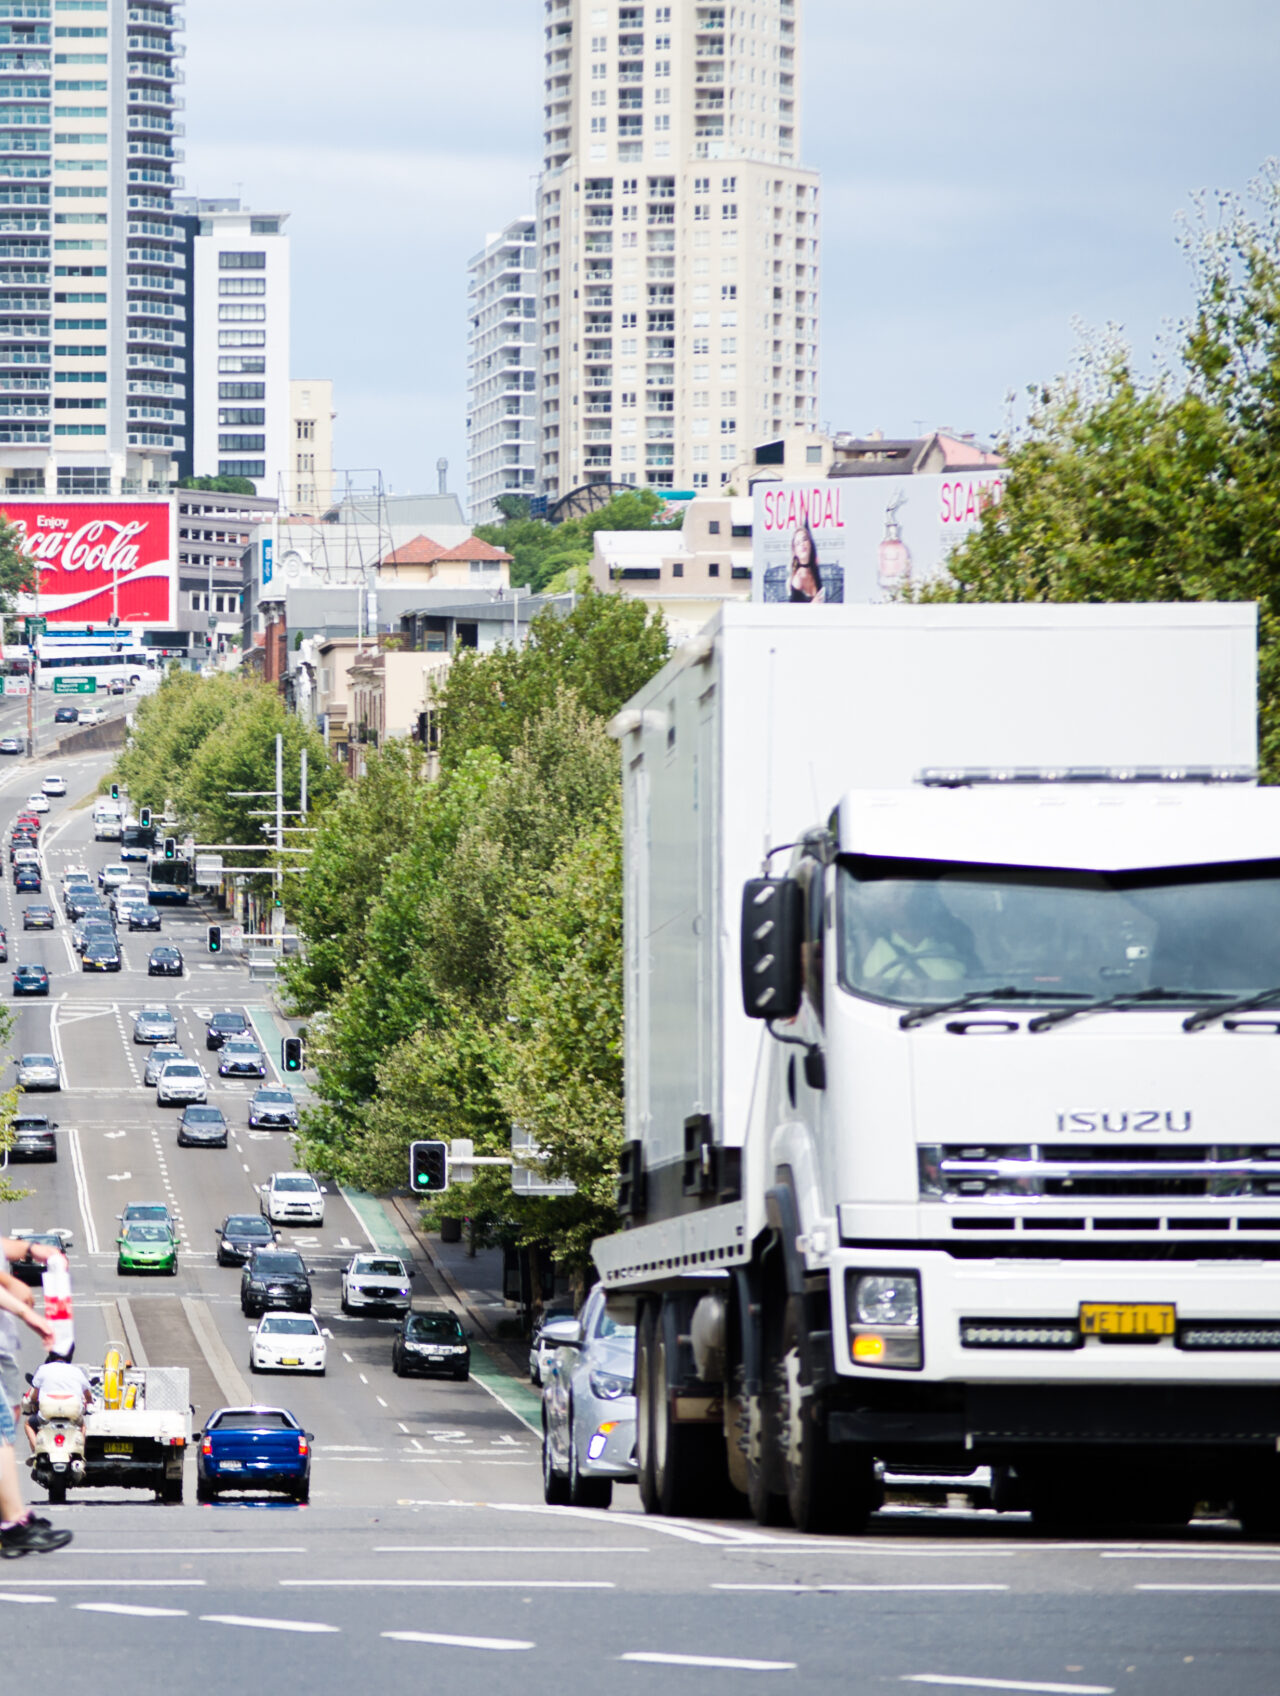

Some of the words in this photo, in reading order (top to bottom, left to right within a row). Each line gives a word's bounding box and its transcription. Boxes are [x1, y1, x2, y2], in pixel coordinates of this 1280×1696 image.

[764, 487, 844, 531] SCANDAL
[940, 480, 1004, 523] SCAND
[37, 515, 69, 530] Enjoy
[1057, 1110, 1192, 1133] ISUZU
